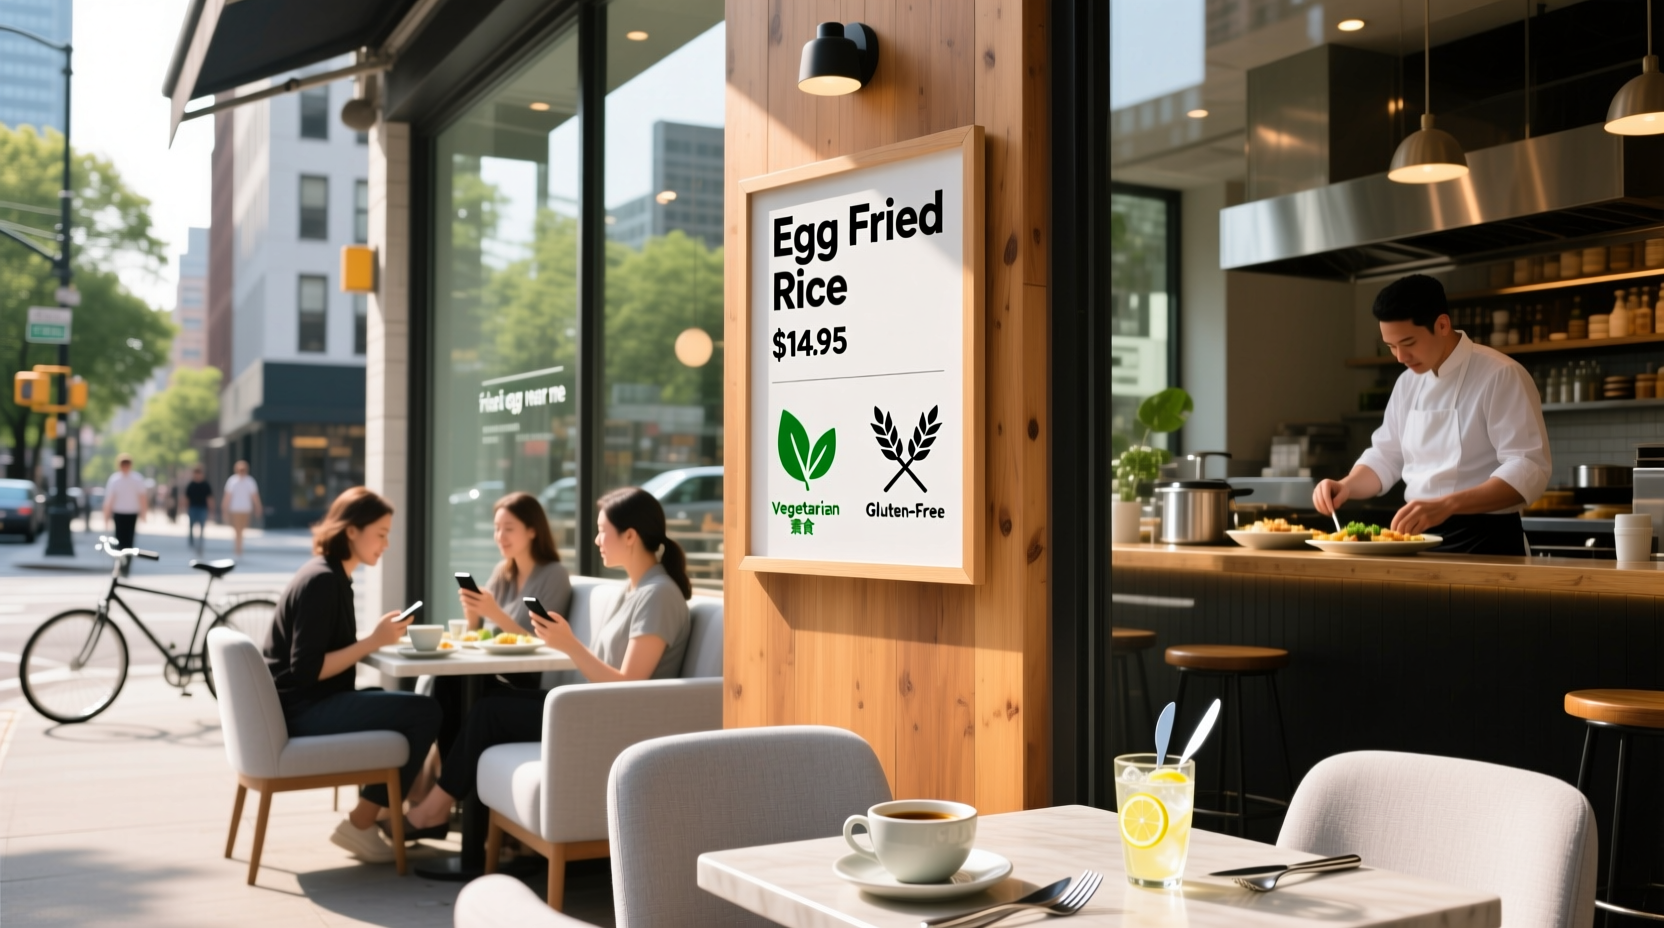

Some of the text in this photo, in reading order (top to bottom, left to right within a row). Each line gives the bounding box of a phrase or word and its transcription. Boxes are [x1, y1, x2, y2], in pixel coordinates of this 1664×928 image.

[774, 189, 943, 265] Egg Fried
[774, 268, 848, 311] Rice
[773, 326, 848, 362] $14.95
[772, 500, 840, 518] Vegetarian
[866, 502, 945, 518] Gluten-Free
